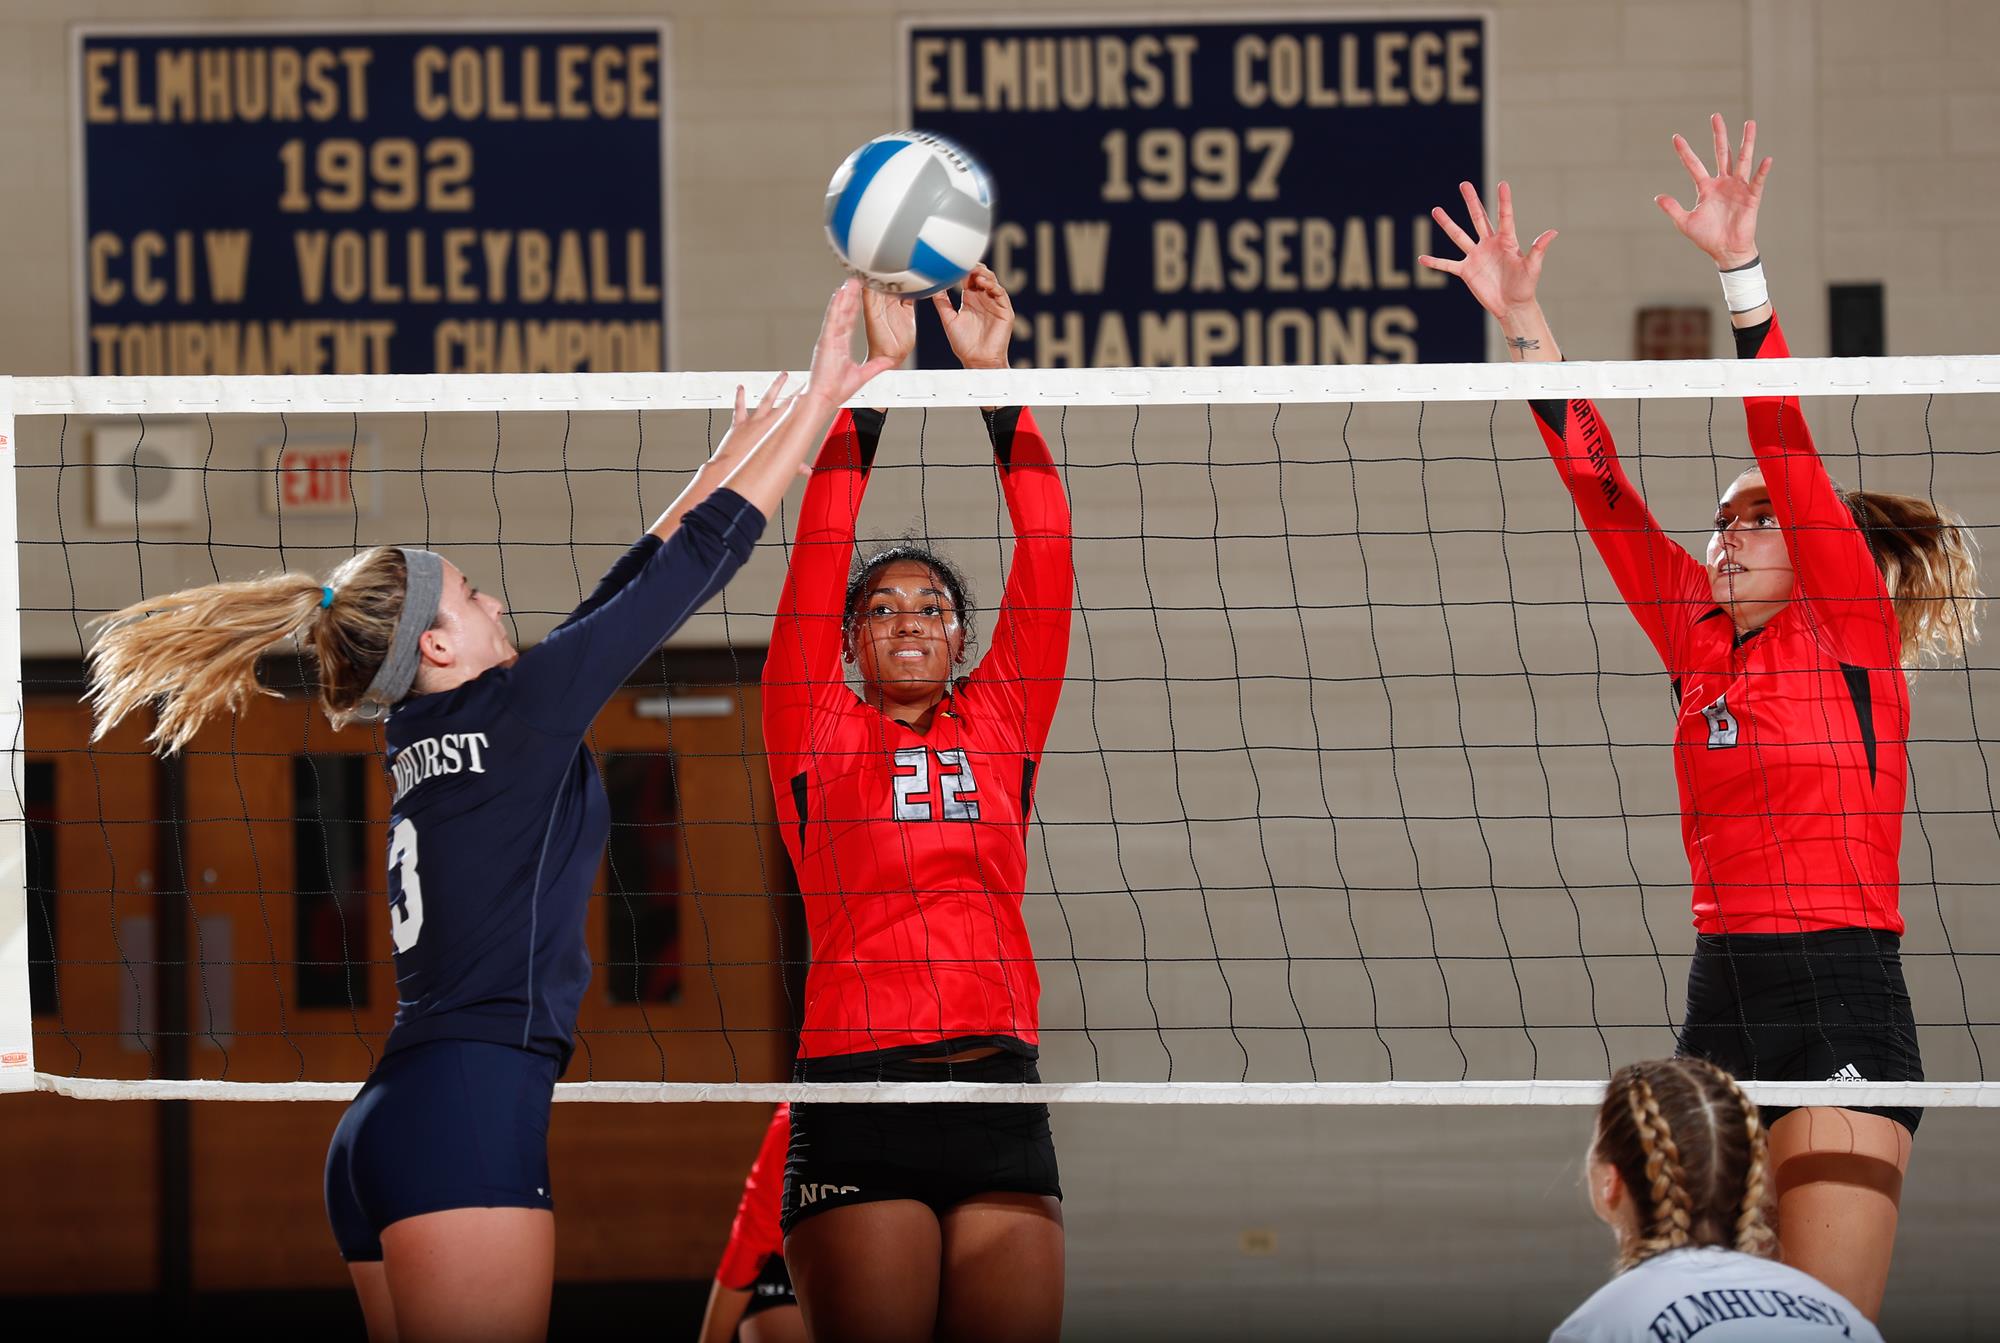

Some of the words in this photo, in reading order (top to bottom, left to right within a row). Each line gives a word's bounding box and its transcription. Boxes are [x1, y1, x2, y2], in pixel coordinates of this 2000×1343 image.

[85, 46, 373, 123] ELMHURST
[413, 44, 660, 121] COLLEGE
[913, 35, 1199, 111] ELMHURST
[1234, 31, 1480, 108] COLLEGE
[279, 137, 474, 212] 1992
[1101, 127, 1292, 202] 1997
[89, 229, 252, 306] CCIW
[293, 227, 661, 305] VOLLEYBALL
[1152, 215, 1448, 293] BASEBALL
[283, 450, 351, 504] EXIT
[1570, 399, 1599, 442] ORTH
[1586, 437, 1623, 511] CENTRAL
[1700, 693, 1739, 751] 8
[892, 745, 981, 822] 22
